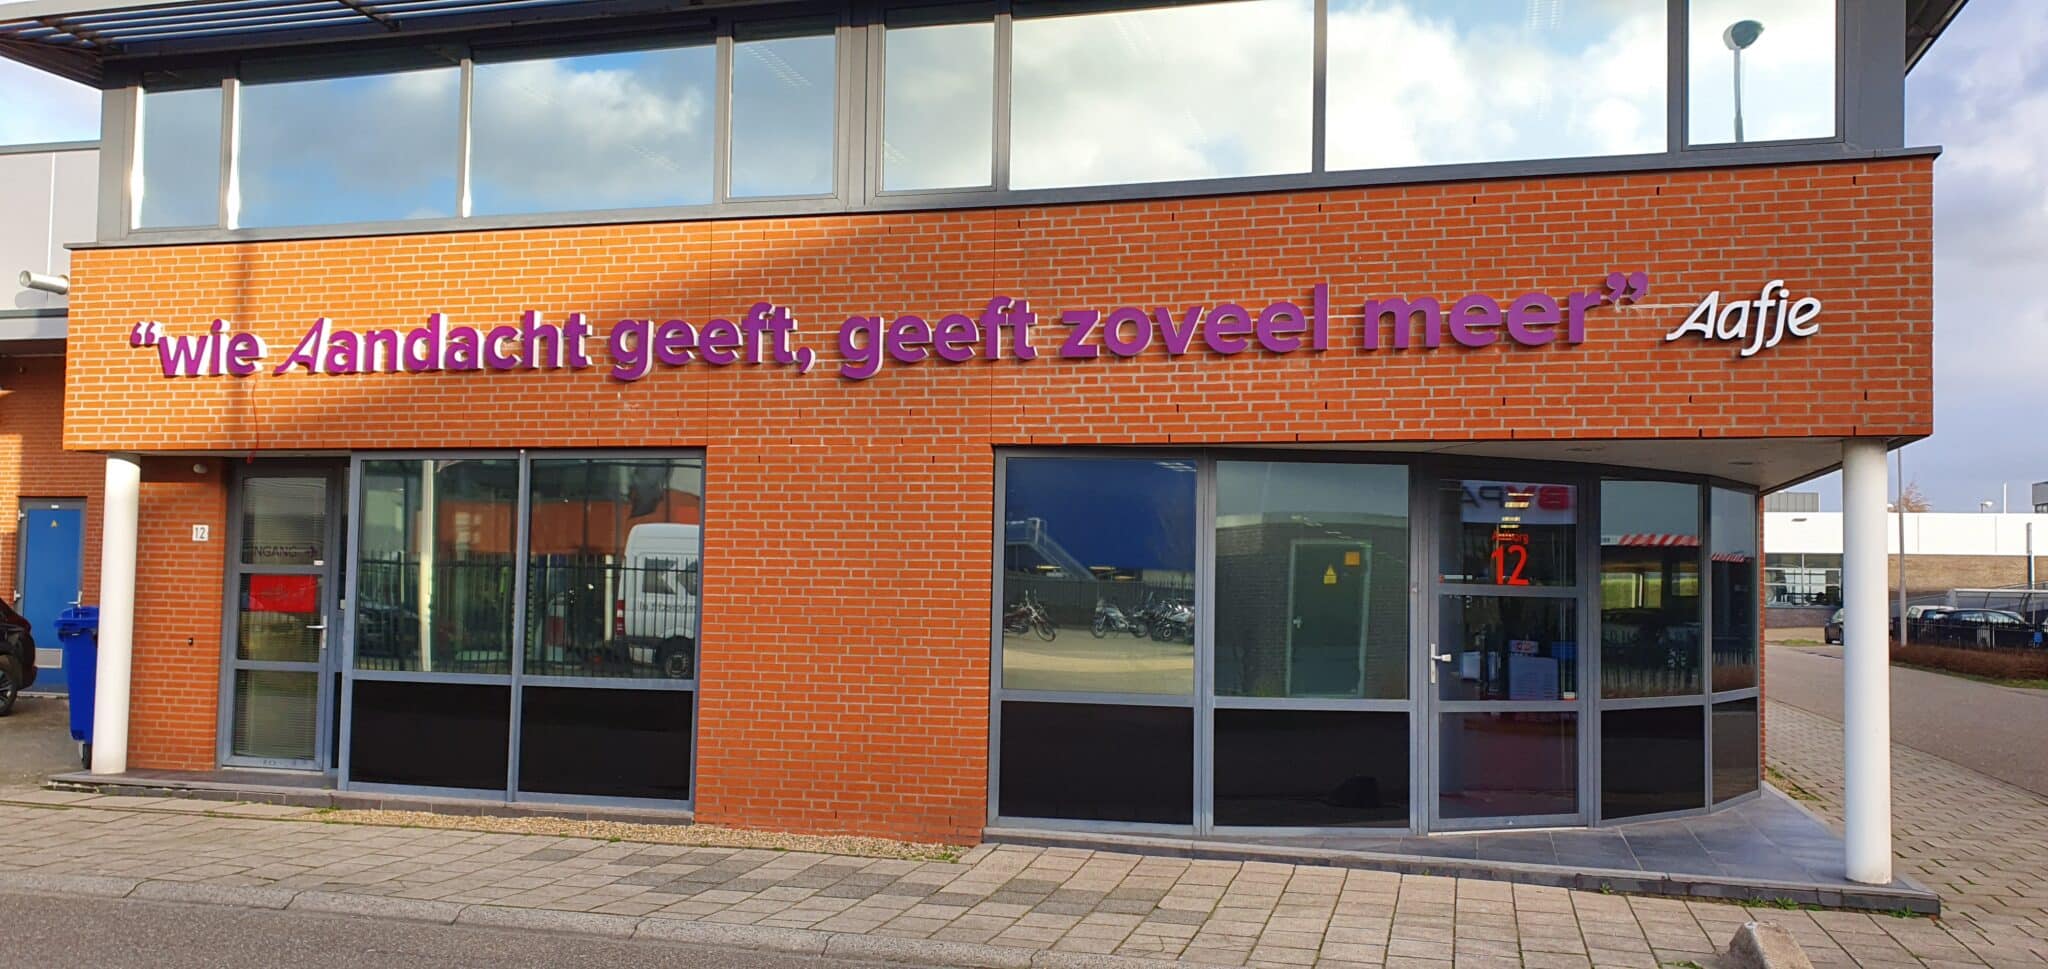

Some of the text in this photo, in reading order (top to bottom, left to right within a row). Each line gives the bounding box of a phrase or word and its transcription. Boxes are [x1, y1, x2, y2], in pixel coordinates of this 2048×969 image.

[275, 311, 593, 376] Aandacht
[609, 302, 815, 384] geeft,
[838, 296, 1038, 381] geeft
[1060, 283, 1330, 358] zoveel
[1666, 279, 1822, 358] Aafje
[194, 526, 207, 540] 12
[1491, 544, 1530, 586] 12
